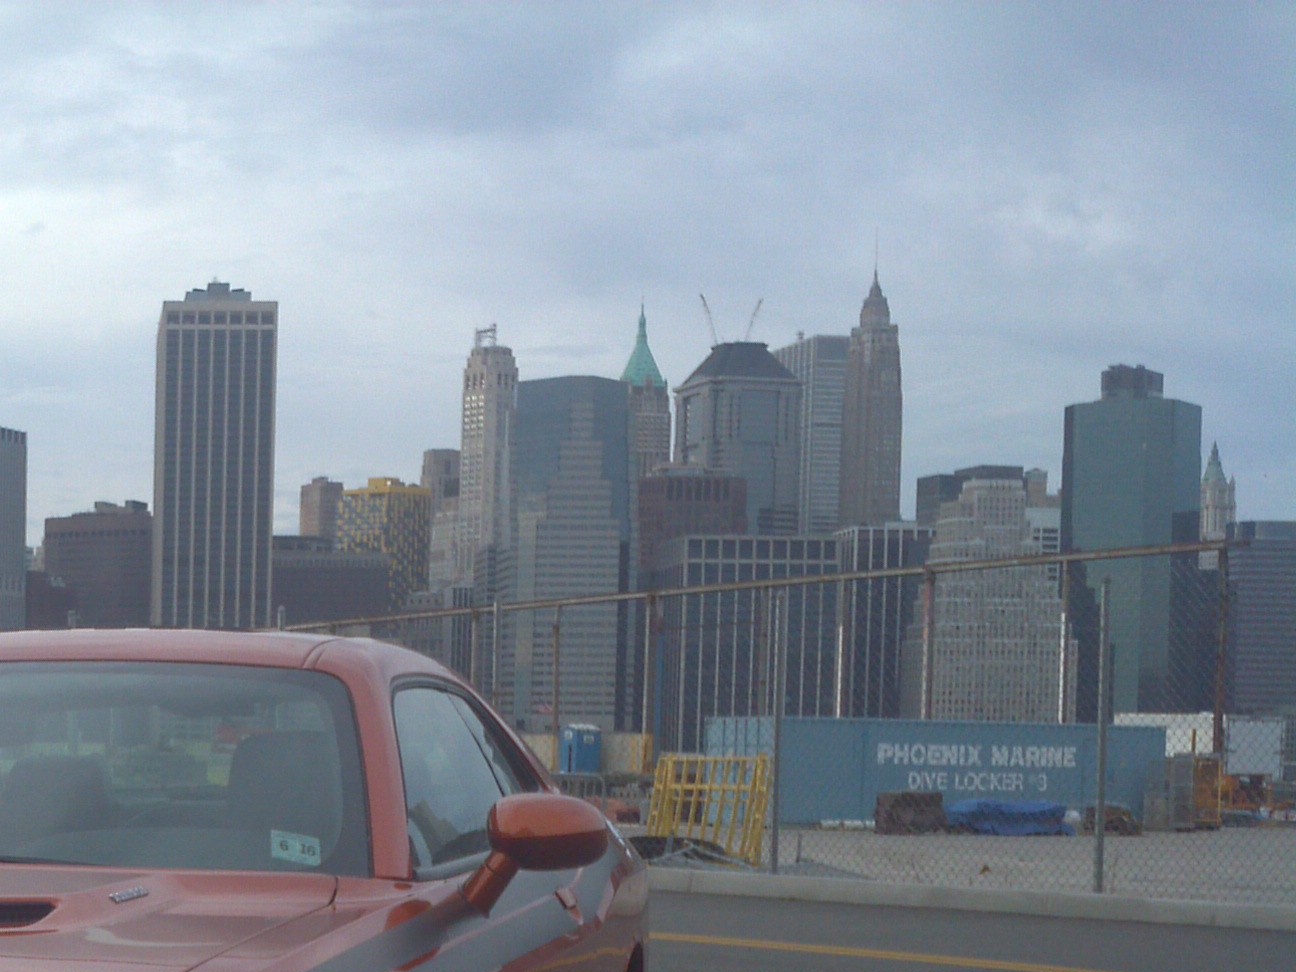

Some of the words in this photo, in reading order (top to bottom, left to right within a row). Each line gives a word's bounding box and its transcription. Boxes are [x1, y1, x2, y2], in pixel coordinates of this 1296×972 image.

[876, 743, 982, 767] PHOENIX
[990, 746, 1077, 768] MARINE
[907, 771, 948, 791] DIVE
[954, 772, 1024, 792] LOCKER
